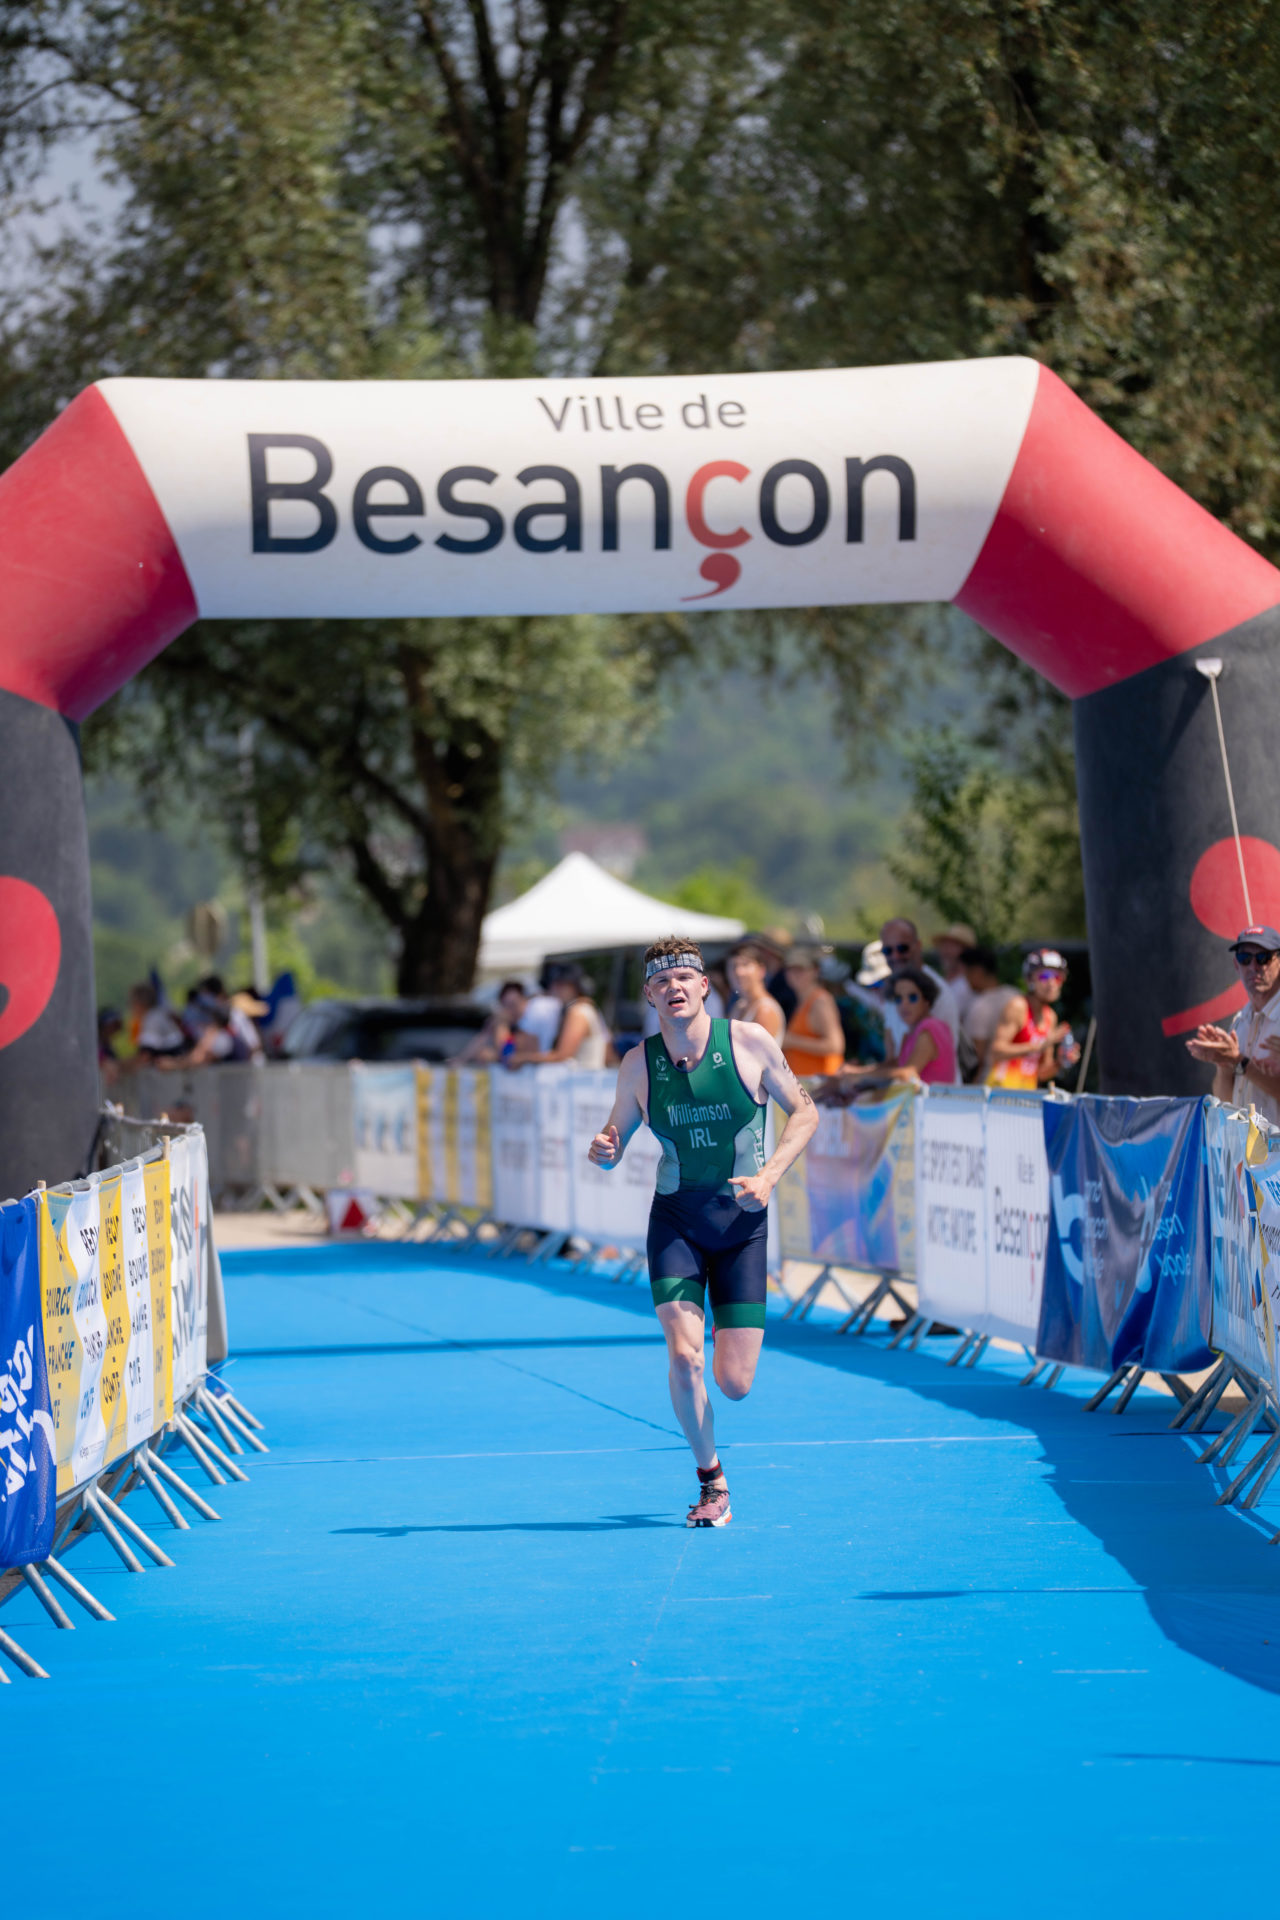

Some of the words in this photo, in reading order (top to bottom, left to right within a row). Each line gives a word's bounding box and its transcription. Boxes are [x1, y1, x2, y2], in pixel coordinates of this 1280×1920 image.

[536, 395, 664, 432] Ville
[681, 393, 746, 429] de
[246, 432, 918, 603] Besançon
[667, 1103, 732, 1128] Williamson
[689, 1127, 718, 1149] IRL
